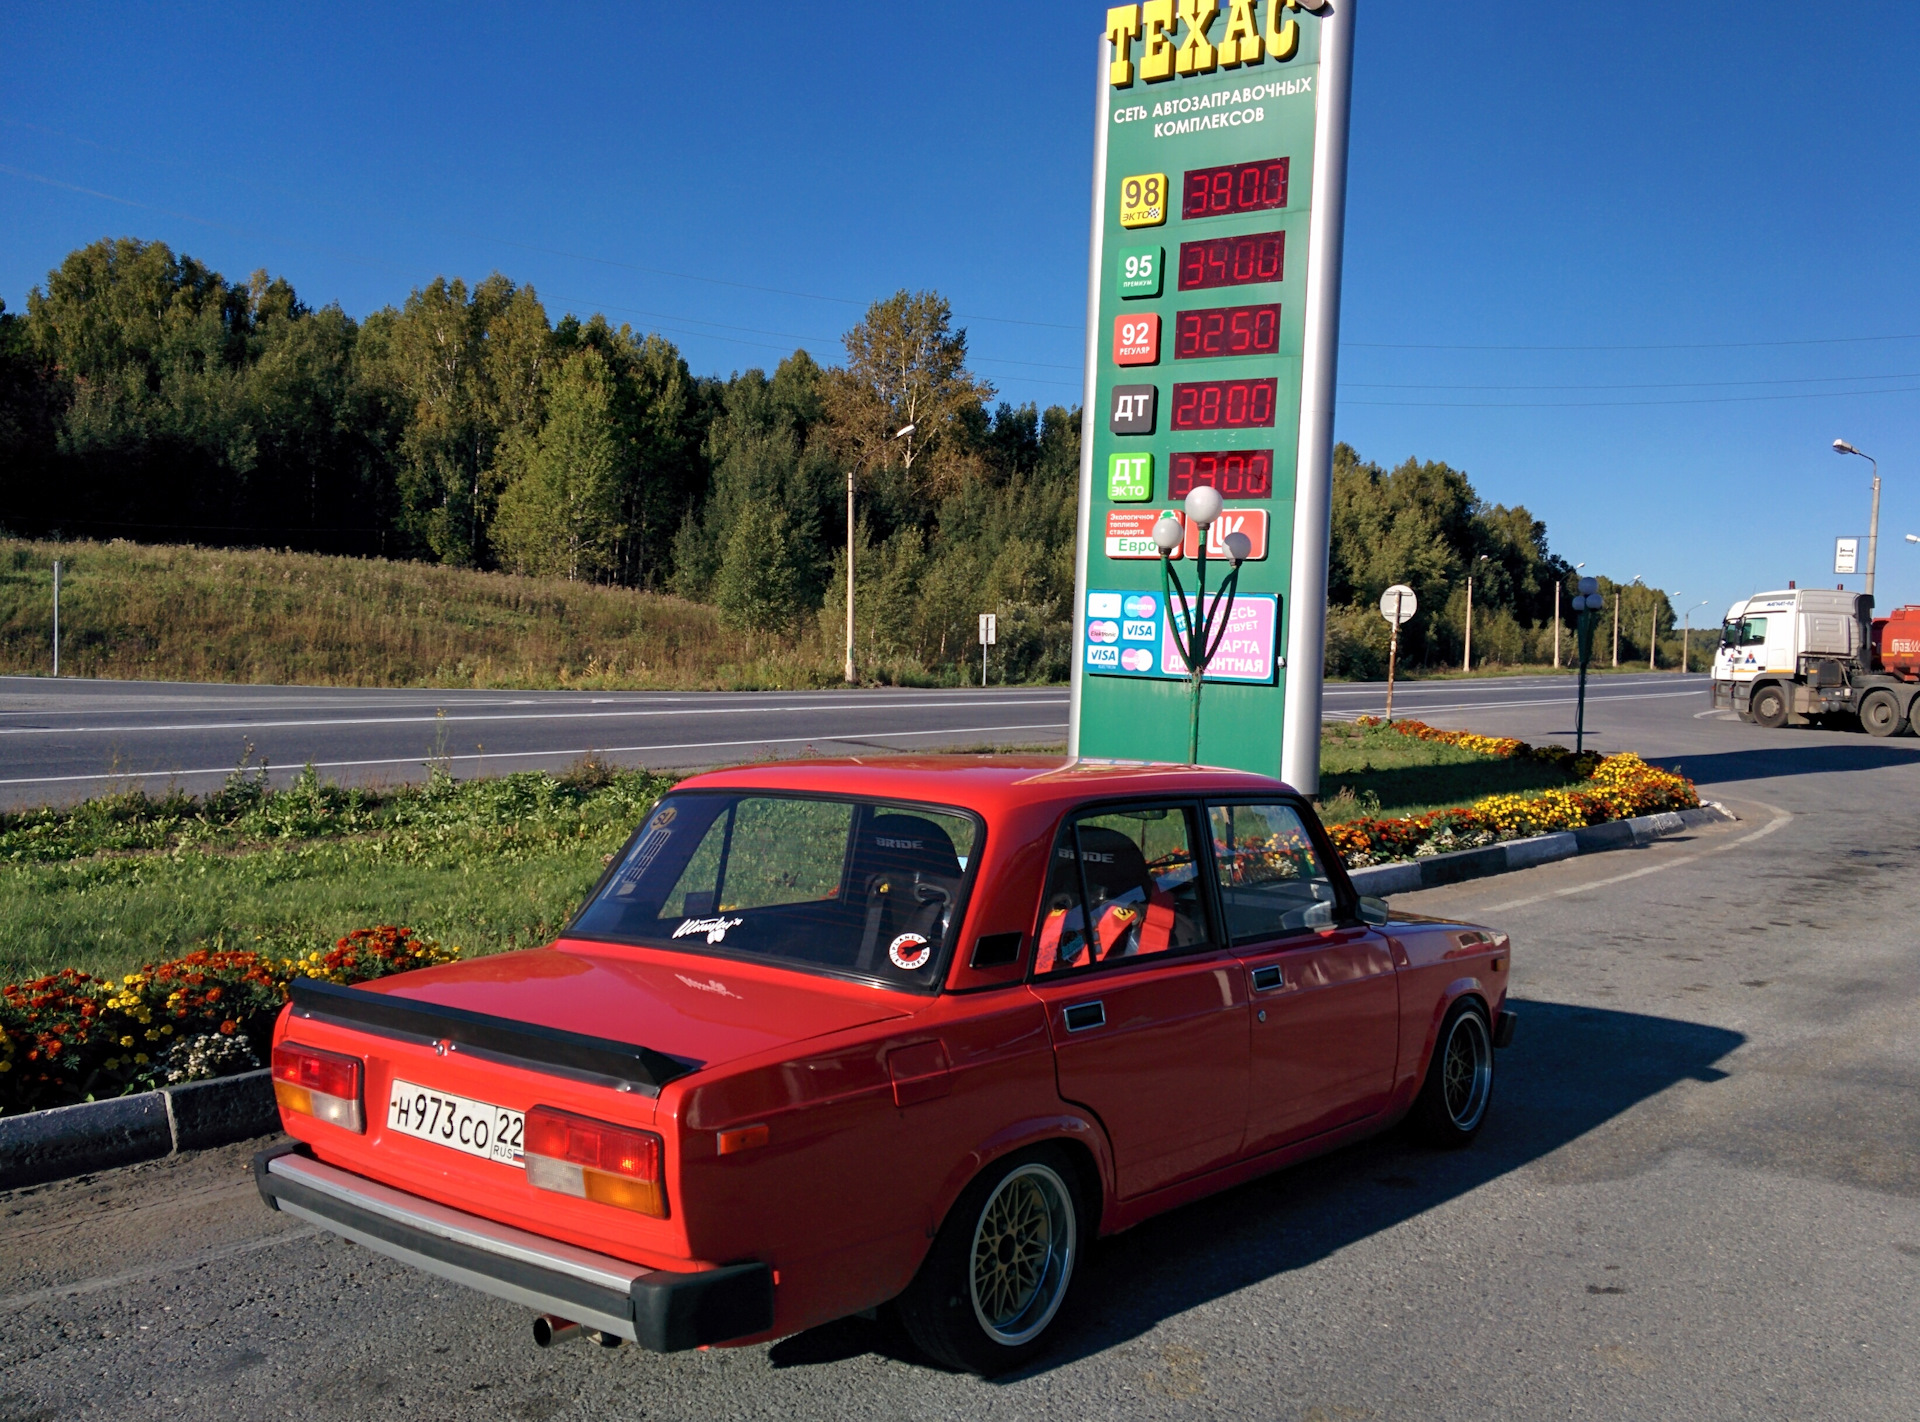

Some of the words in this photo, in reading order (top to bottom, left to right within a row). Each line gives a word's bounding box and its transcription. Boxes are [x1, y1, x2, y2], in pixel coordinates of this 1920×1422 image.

[1106, 0, 1300, 87] ТЕХАС
[1113, 105, 1148, 124] СЕТЬ
[1151, 76, 1313, 118] АВТОЗАПРАВОЧНЫХ
[1153, 107, 1265, 138] КОМПЛЕКСОВ
[1125, 177, 1160, 209] 98
[1122, 210, 1150, 222] ЭКТО
[1124, 254, 1153, 279] 95
[1123, 279, 1153, 288] ПРЕМИУМ
[1121, 322, 1149, 346] 92
[1119, 346, 1151, 356] РЕГУЛЯР
[1114, 395, 1150, 422] ДТ
[1112, 458, 1146, 485] ДТ
[1111, 485, 1145, 497] ЭКТО
[1110, 513, 1155, 521] Экологичное
[1118, 538, 1157, 554] Евро
[1127, 625, 1153, 636] VISA
[1091, 649, 1116, 661] VISA
[875, 837, 924, 849] BRIDE
[891, 934, 923, 951] PLANET
[895, 950, 929, 968] EXPRESS
[496, 1113, 523, 1148] 22
[493, 1144, 513, 1160] RUS
